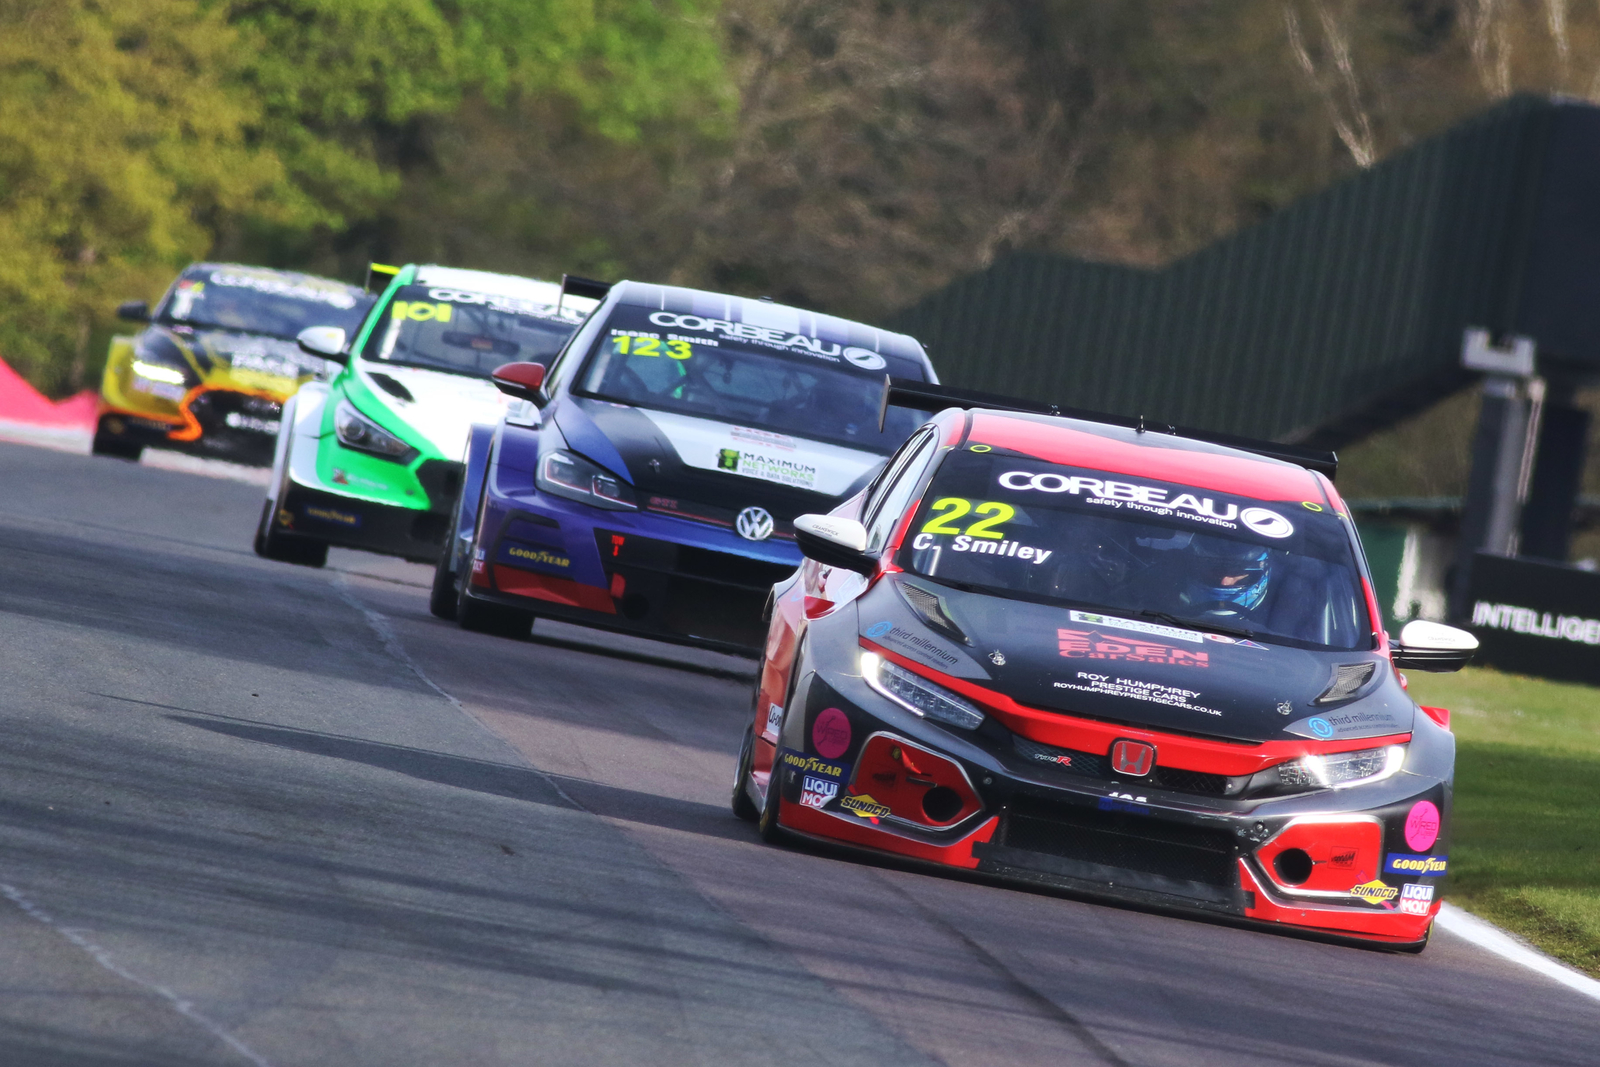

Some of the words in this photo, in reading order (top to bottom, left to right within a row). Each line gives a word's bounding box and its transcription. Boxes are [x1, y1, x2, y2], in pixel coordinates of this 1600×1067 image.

[649, 311, 842, 357] CORBEAU
[667, 333, 719, 346] Smith
[612, 335, 692, 359] 123
[719, 333, 749, 345] safety
[751, 339, 789, 351] through
[791, 347, 841, 363] innovation
[742, 460, 815, 481] NETWORKS
[744, 452, 816, 474] MAXIMUM
[999, 471, 1238, 521] CORBEAU
[921, 497, 1015, 539] 22
[1086, 497, 1123, 509] safety
[1127, 500, 1173, 516] through
[1176, 509, 1237, 530] innovation
[611, 535, 625, 546] TOW
[812, 524, 839, 536] CRANSWICK
[913, 533, 941, 551] C.
[952, 535, 1052, 565] Smiley
[889, 627, 912, 640] third
[910, 636, 958, 665] millennium
[1058, 641, 1209, 662] EDEN
[1059, 649, 1209, 668] CarSales
[1077, 671, 1109, 682] ROY
[1116, 677, 1201, 699] HUMPHREY
[1091, 681, 1150, 696] PRESTIGE
[1152, 691, 1187, 703] CARS
[1053, 682, 1222, 717] ROYHUMPHREYPRESTIGECARS.CO.UK
[1328, 714, 1351, 726] third
[1352, 712, 1395, 724] millennium
[805, 778, 838, 797] LIQUI
[842, 797, 889, 817] SUNOCO
[1353, 885, 1396, 899] SUNOCO
[1403, 885, 1433, 900] LIQUI
[1401, 900, 1431, 914] MOLY
